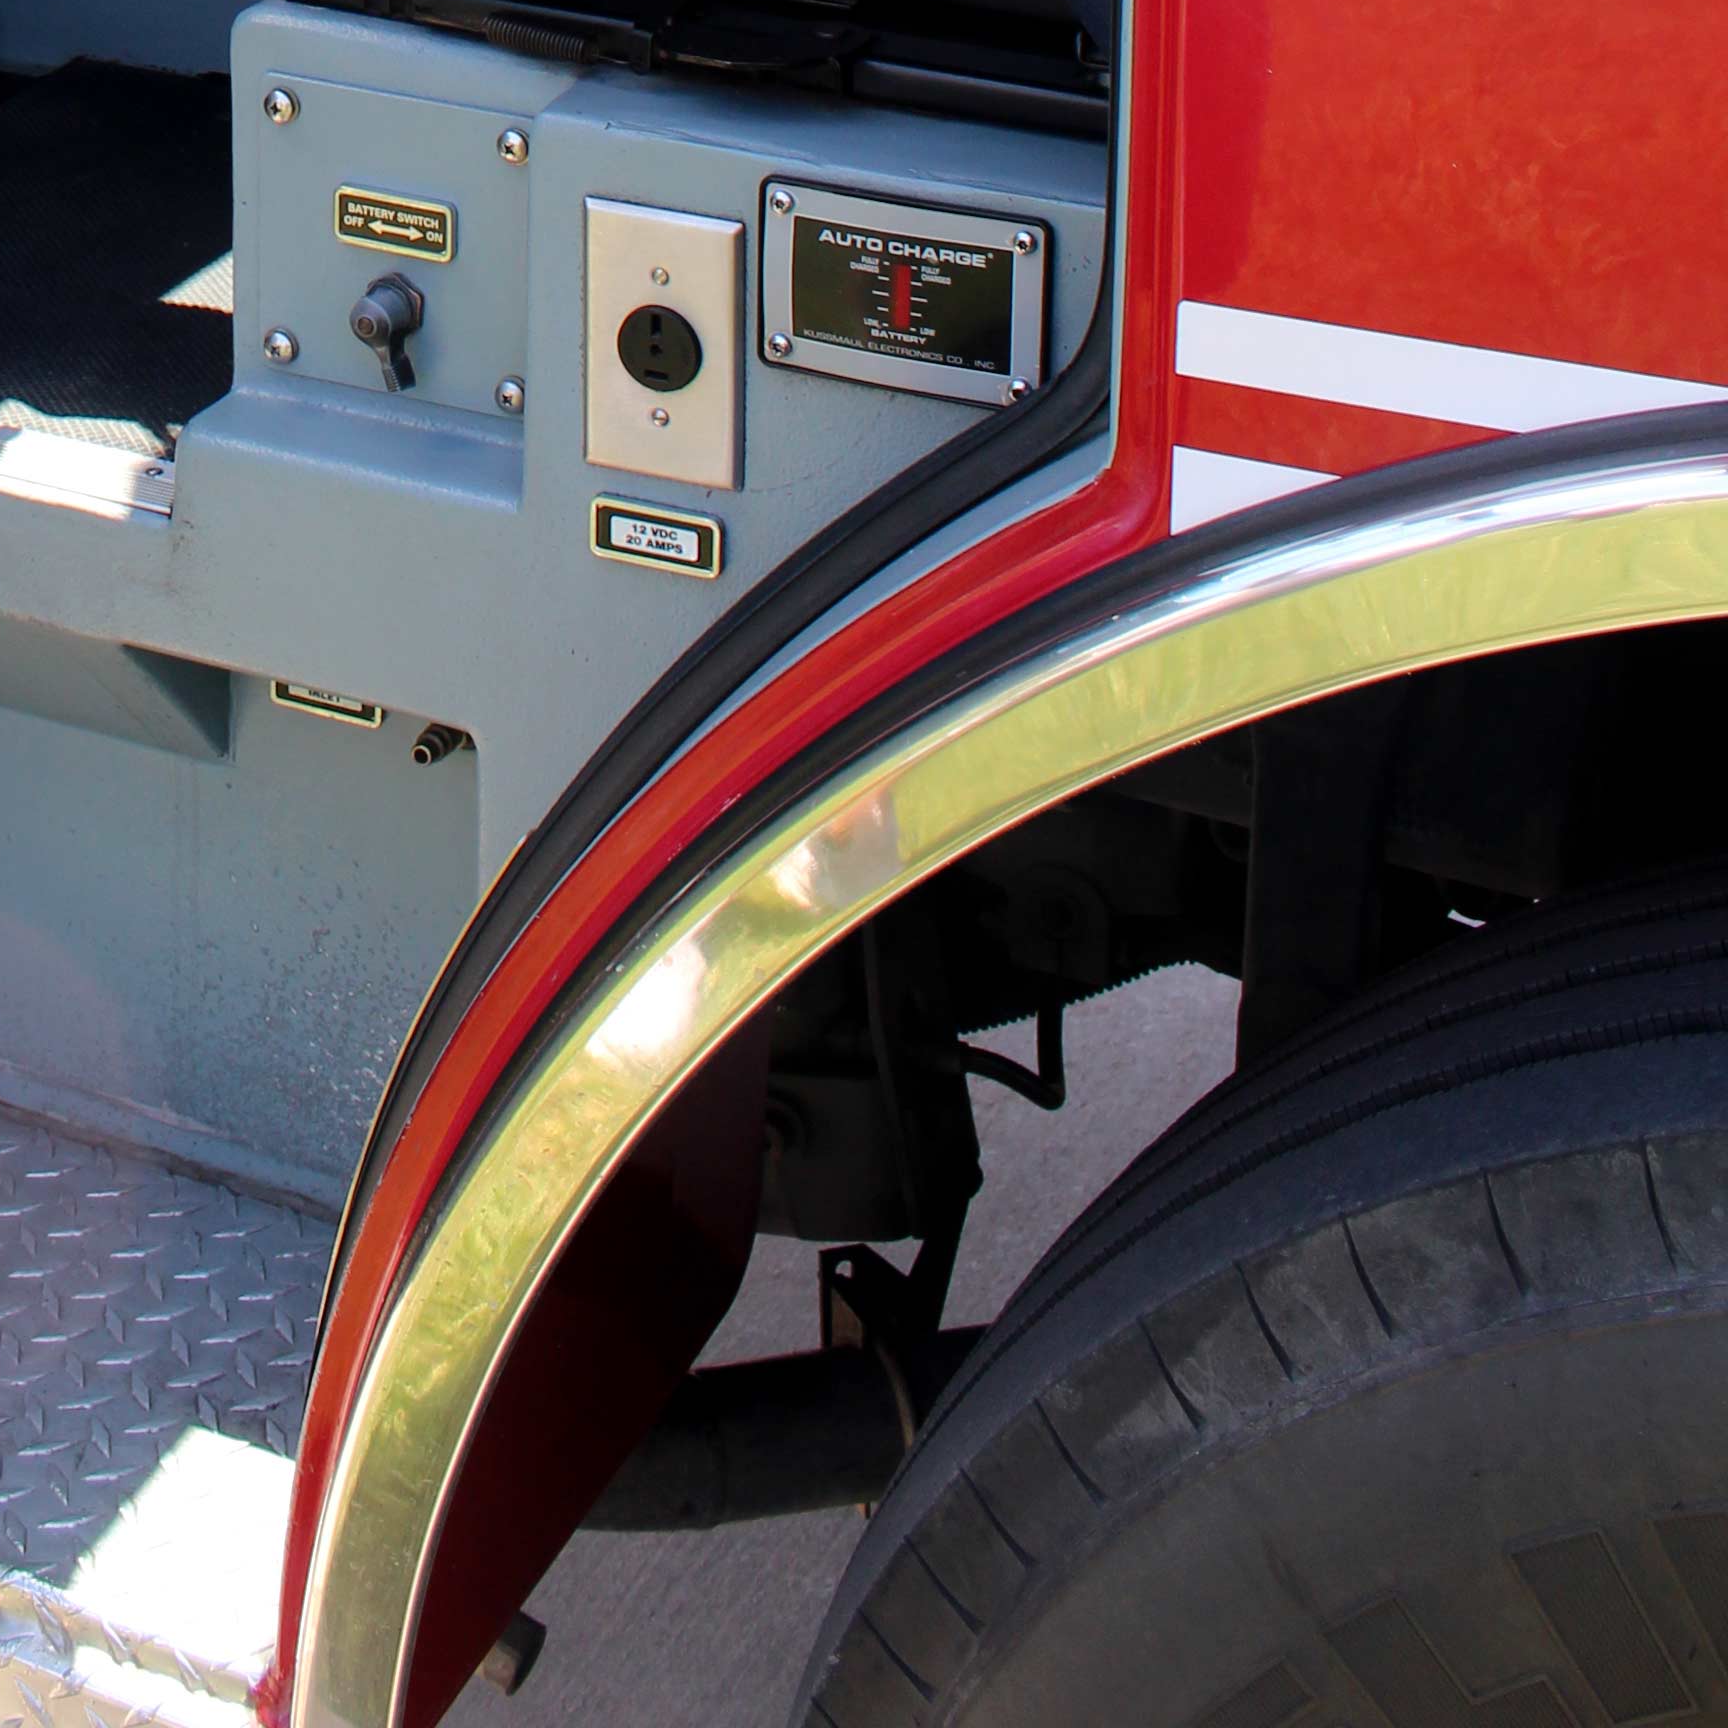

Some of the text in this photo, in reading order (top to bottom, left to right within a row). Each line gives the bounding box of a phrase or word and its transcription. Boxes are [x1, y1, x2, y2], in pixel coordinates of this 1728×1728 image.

[343, 215, 365, 228] OFF
[347, 202, 439, 230] BATTERY SWITCH
[425, 231, 443, 244] ON
[818, 229, 883, 252] AUTO
[803, 328, 865, 348] KUSSMAUL
[867, 340, 944, 361] ELECTRONICS
[870, 328, 927, 345] BATTERY
[631, 524, 678, 541] 12 VDC
[625, 535, 683, 554] 20 AMPS
